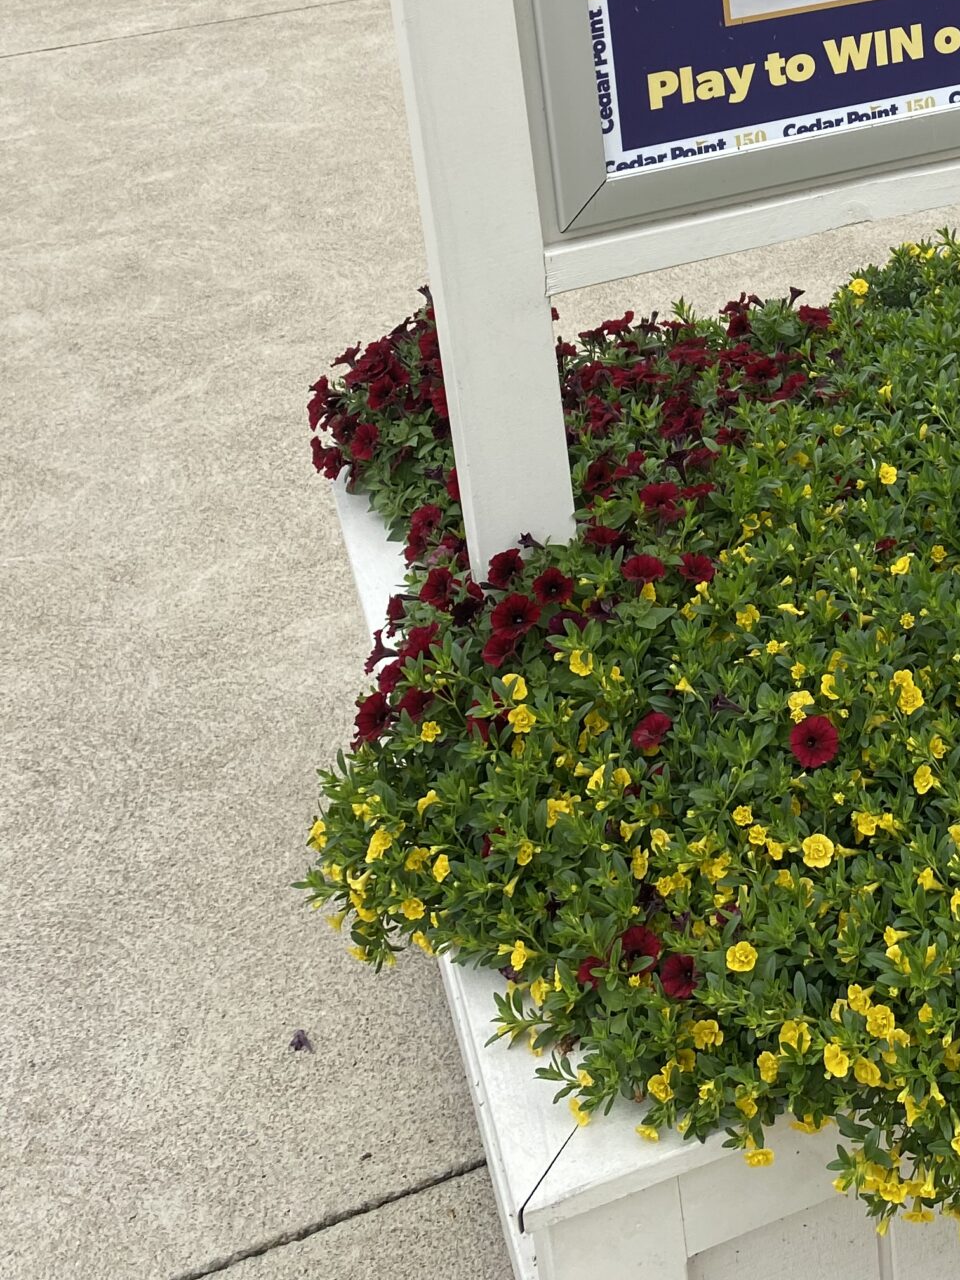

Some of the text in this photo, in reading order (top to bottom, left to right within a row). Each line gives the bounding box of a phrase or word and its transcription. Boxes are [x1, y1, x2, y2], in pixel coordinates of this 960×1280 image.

[647, 63, 755, 110] Play
[764, 52, 815, 86] to
[823, 24, 924, 75] WIN
